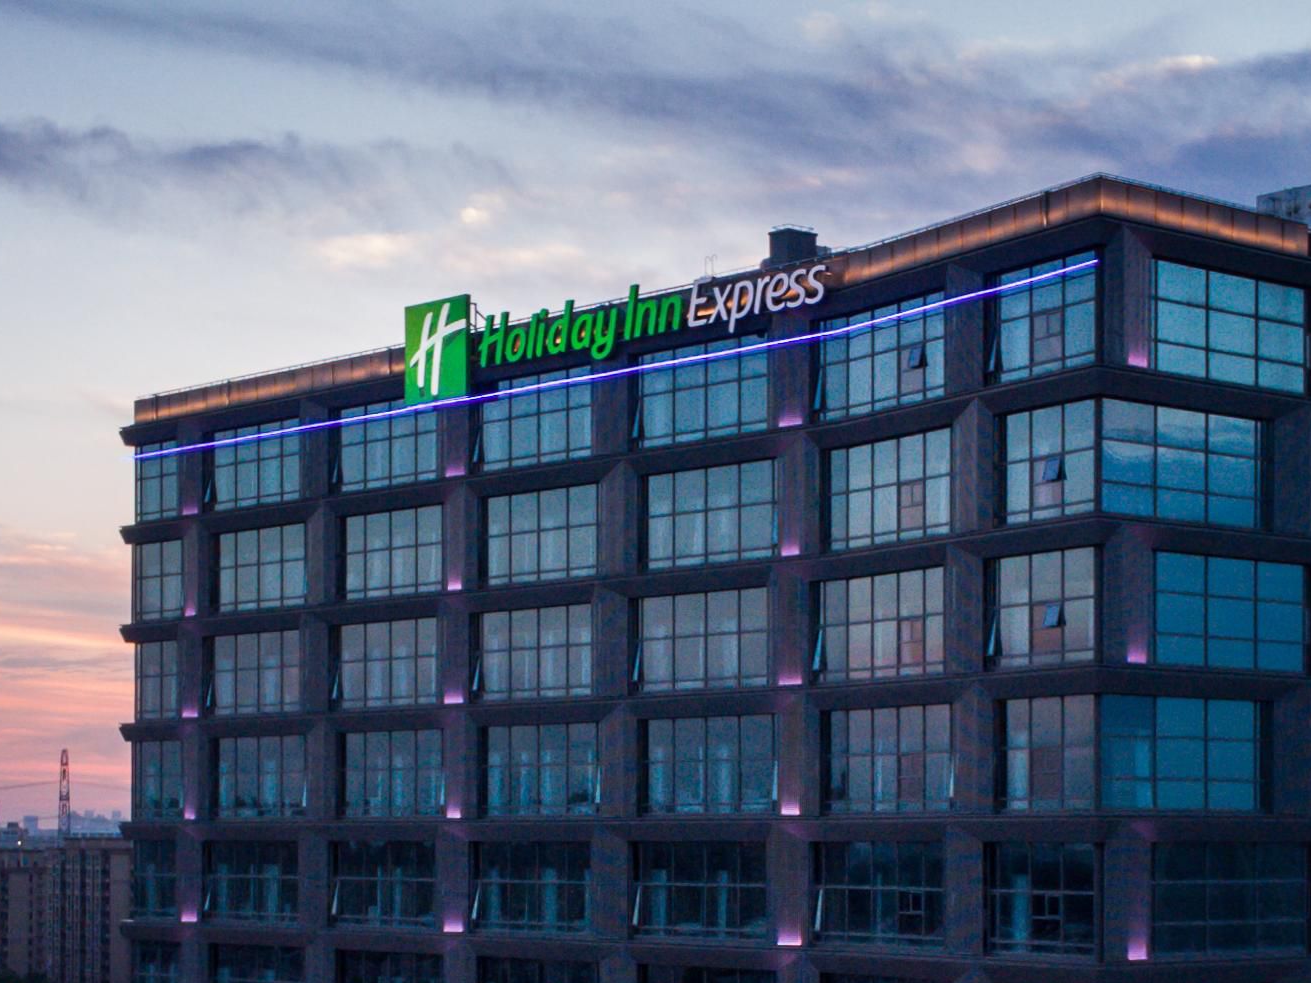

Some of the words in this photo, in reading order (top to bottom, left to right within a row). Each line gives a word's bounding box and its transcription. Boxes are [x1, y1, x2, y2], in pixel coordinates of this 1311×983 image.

[478, 299, 619, 367] Holiday
[623, 284, 683, 341] Inn
[687, 264, 827, 333] Express
